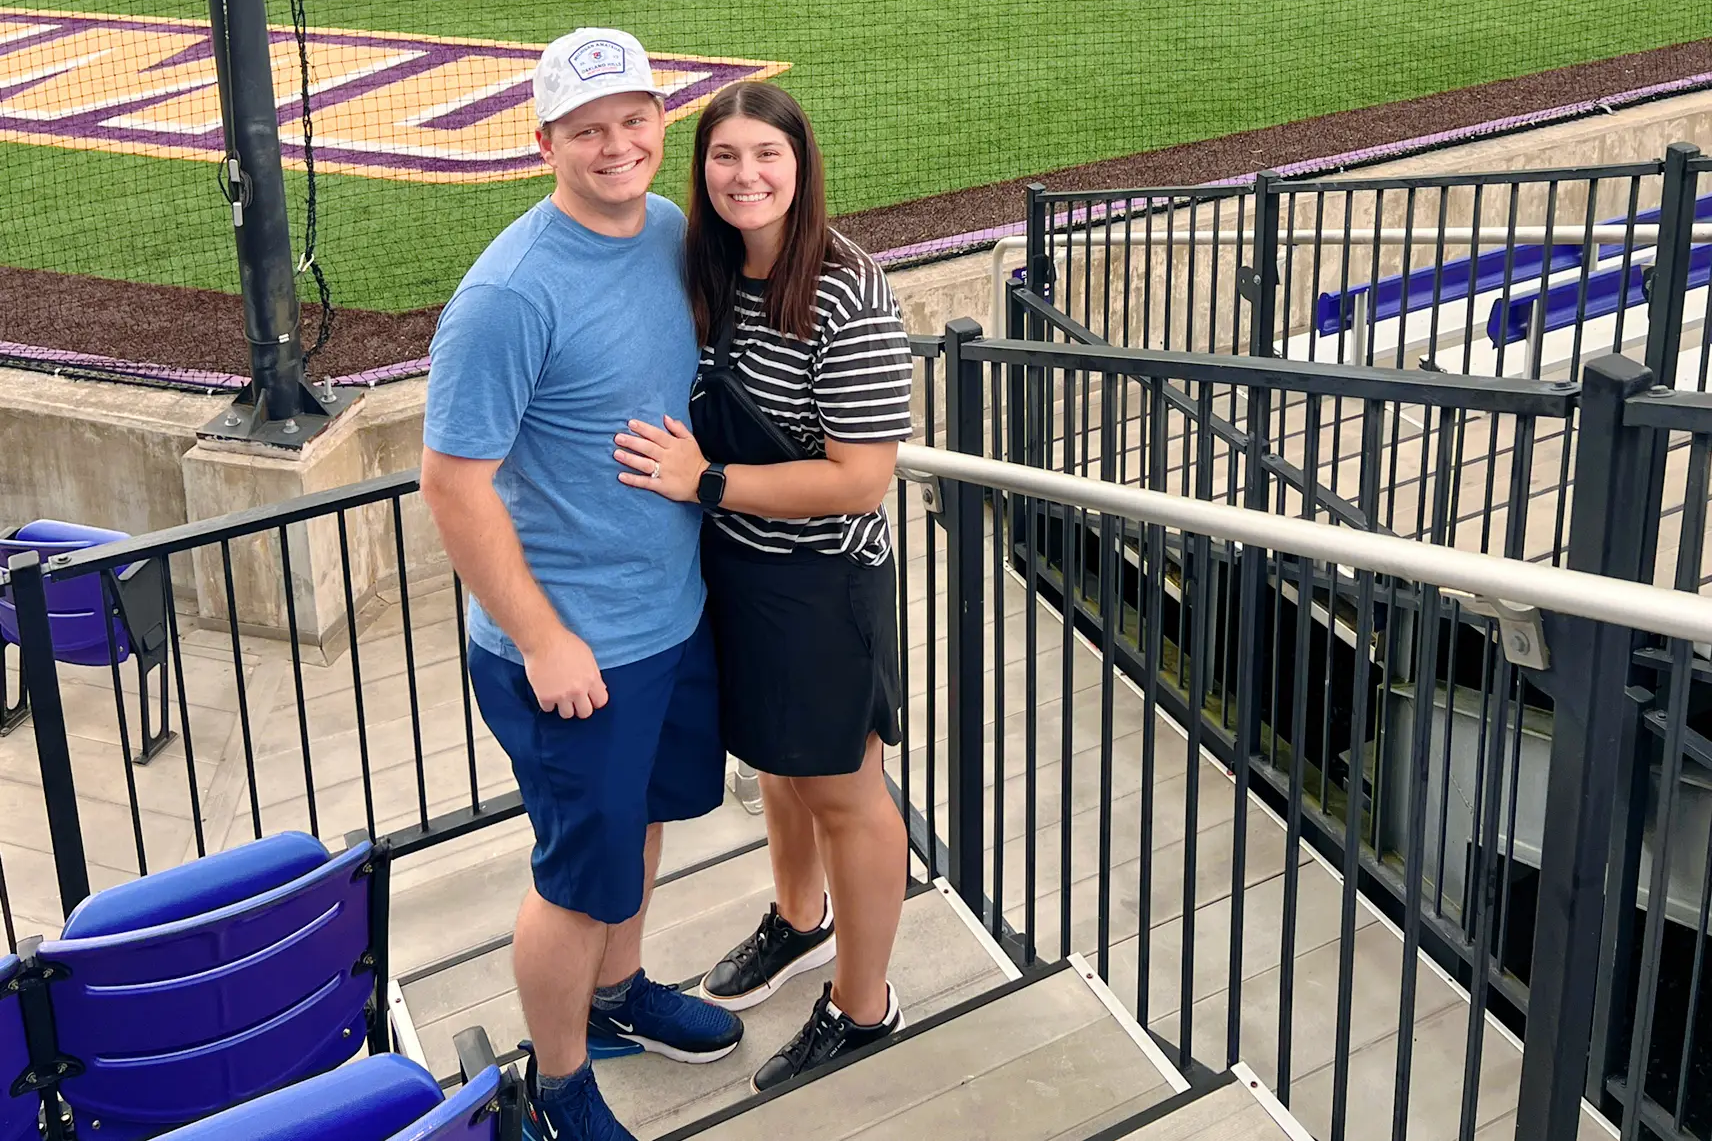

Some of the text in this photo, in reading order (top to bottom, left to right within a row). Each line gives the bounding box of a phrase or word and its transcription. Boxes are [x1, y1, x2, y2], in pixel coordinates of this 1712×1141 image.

[596, 43, 621, 52] AMATEUR
[582, 63, 606, 74] OAKLAND
[0, 7, 793, 181] MU
